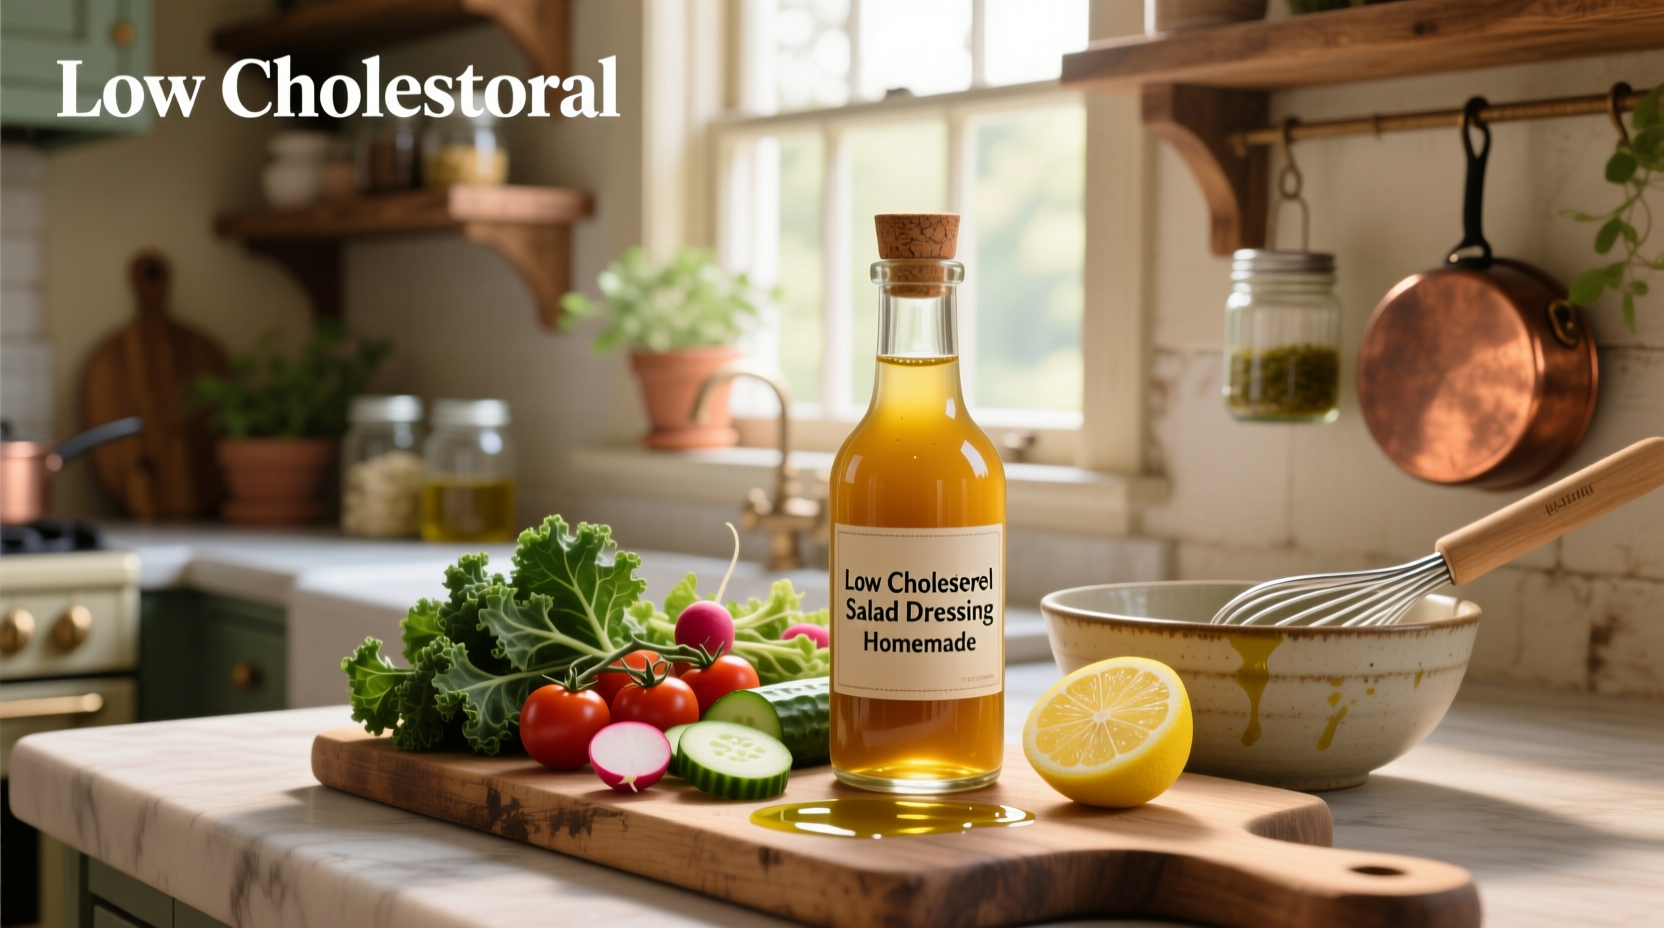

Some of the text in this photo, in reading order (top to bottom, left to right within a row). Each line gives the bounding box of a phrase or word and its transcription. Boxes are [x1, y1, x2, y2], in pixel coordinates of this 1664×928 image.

[845, 568, 882, 593] Low
[845, 597, 994, 626] Salad Dressing
[863, 630, 977, 653] Homemade
